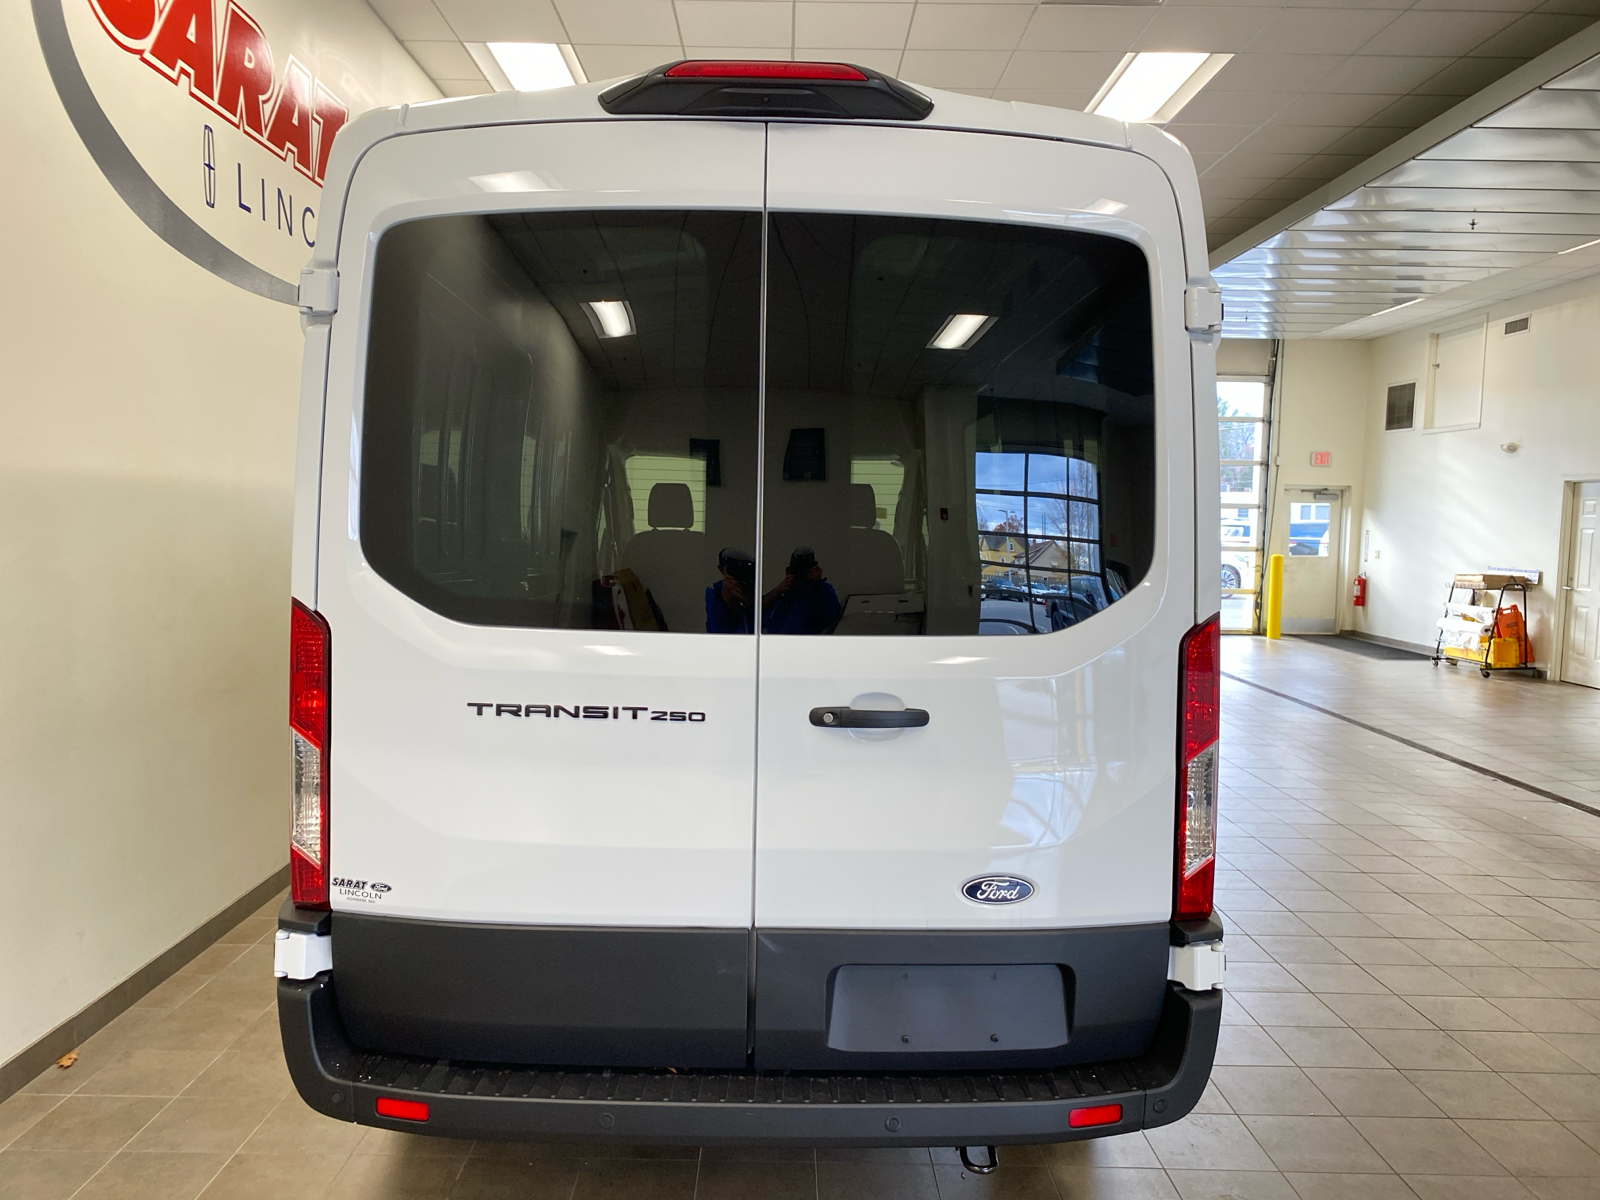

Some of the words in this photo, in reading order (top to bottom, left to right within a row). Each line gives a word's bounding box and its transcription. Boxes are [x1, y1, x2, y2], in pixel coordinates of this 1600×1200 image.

[1314, 451, 1330, 465] EXIT
[467, 702, 649, 720] TRANSIT
[650, 711, 706, 722] 250
[331, 876, 368, 890] SARAT
[976, 880, 1021, 900] Ford
[339, 888, 382, 900] LINCOLN
